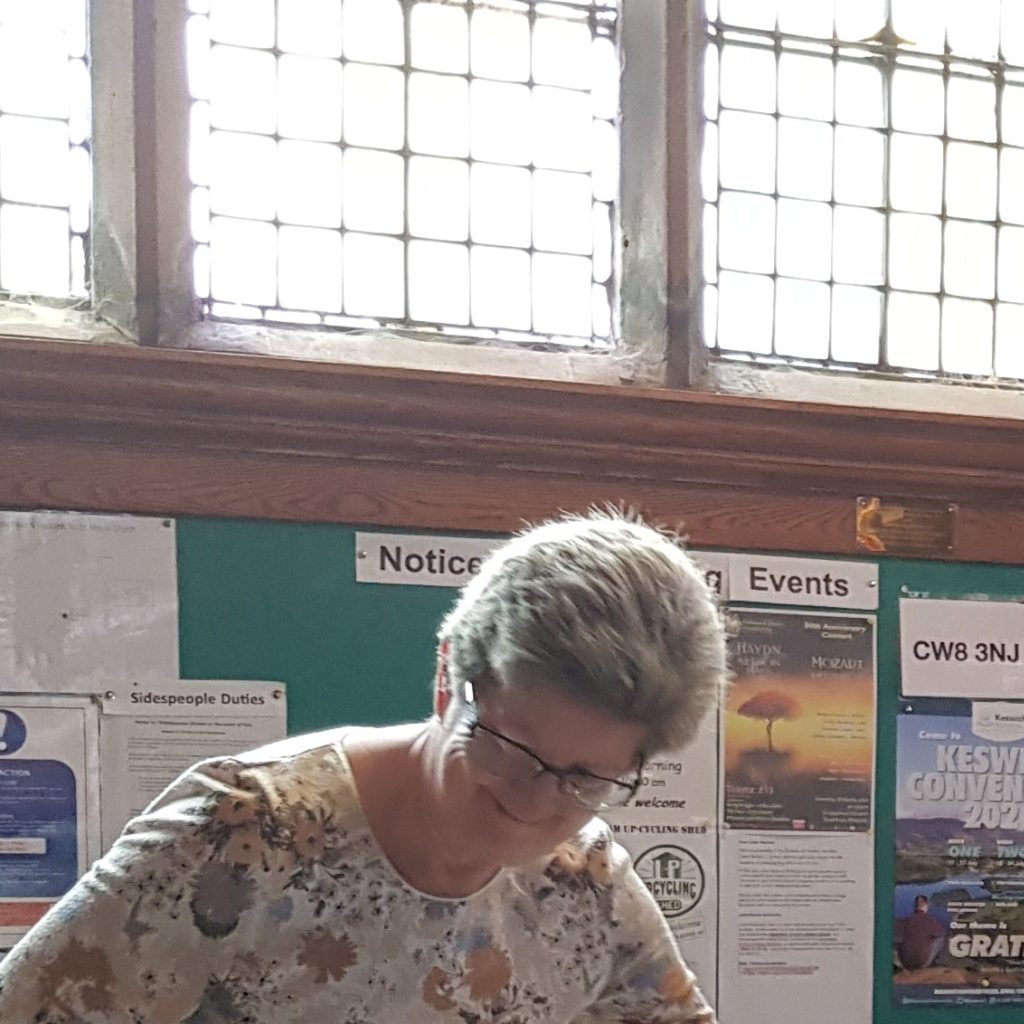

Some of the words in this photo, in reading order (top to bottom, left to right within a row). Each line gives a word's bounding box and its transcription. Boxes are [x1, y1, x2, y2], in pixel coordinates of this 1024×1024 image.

[750, 566, 849, 597] Events
[913, 640, 968, 662] CW8
[974, 642, 1020, 663] 3NJ
[130, 691, 216, 707] Sidespeople
[221, 692, 265, 705] Duties
[635, 796, 686, 809] welcome
[623, 824, 679, 834] UP-CYCLING
[948, 845, 982, 858] ONE
